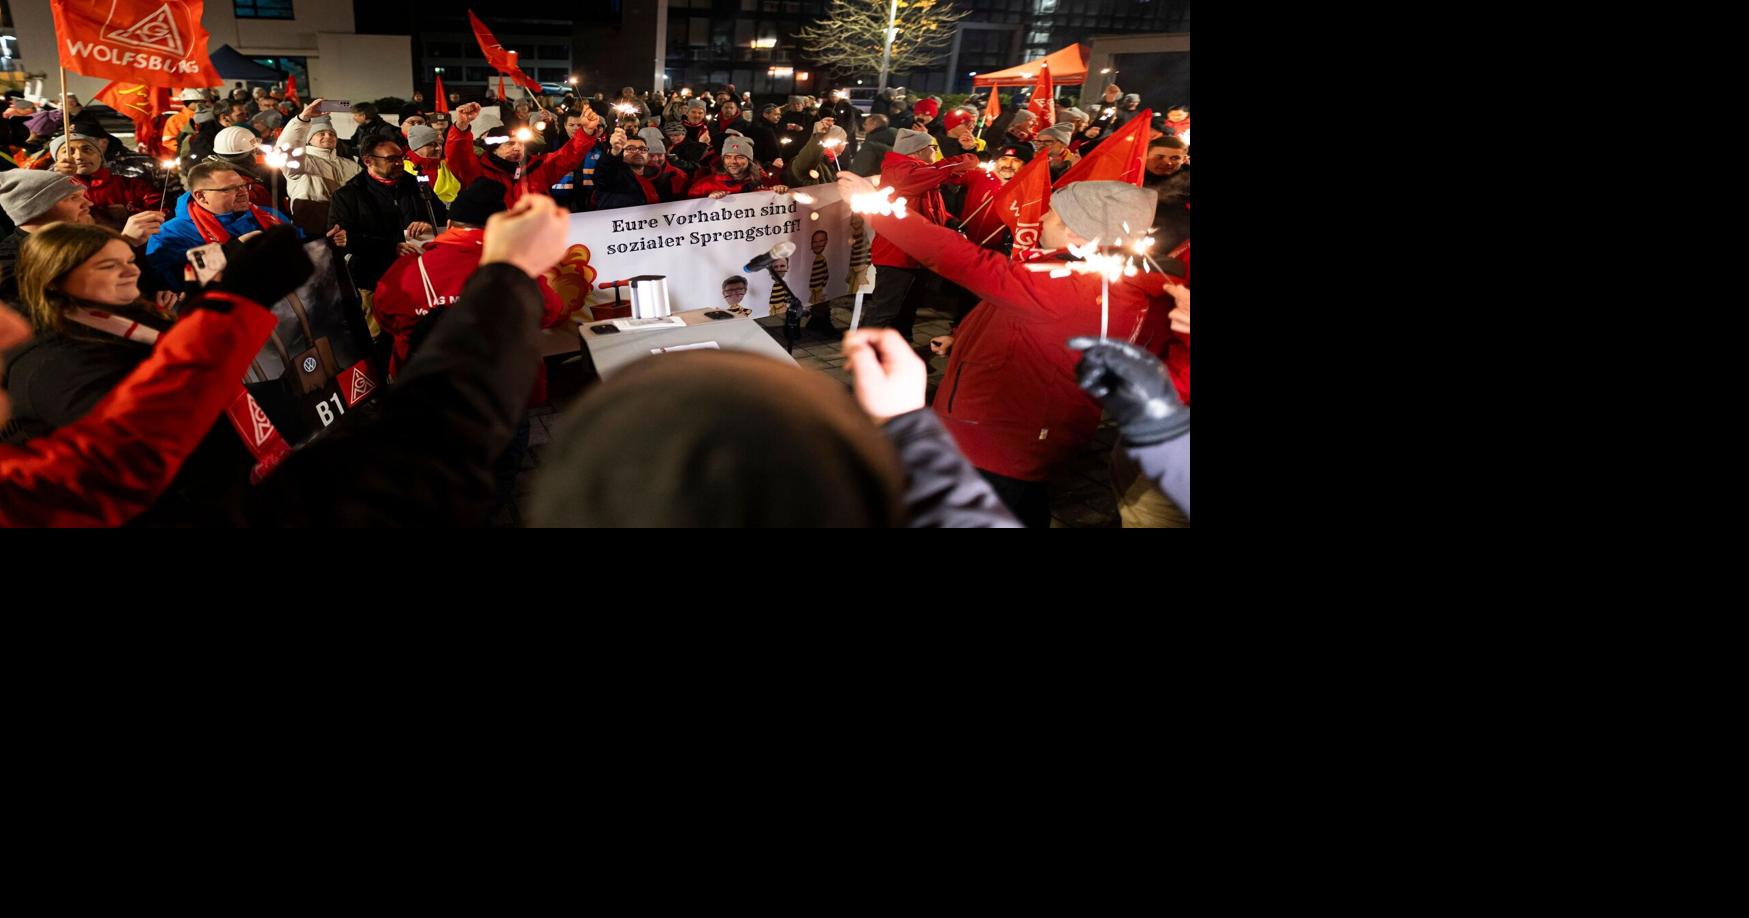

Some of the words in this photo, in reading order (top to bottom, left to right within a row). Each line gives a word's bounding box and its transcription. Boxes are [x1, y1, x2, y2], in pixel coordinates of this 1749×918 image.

[612, 217, 658, 233] Eure
[663, 205, 755, 227] Vorhaben
[760, 201, 798, 217] sind
[606, 235, 684, 255] sozialer
[690, 218, 801, 246] Sprengstoff!
[315, 392, 345, 427] B1
